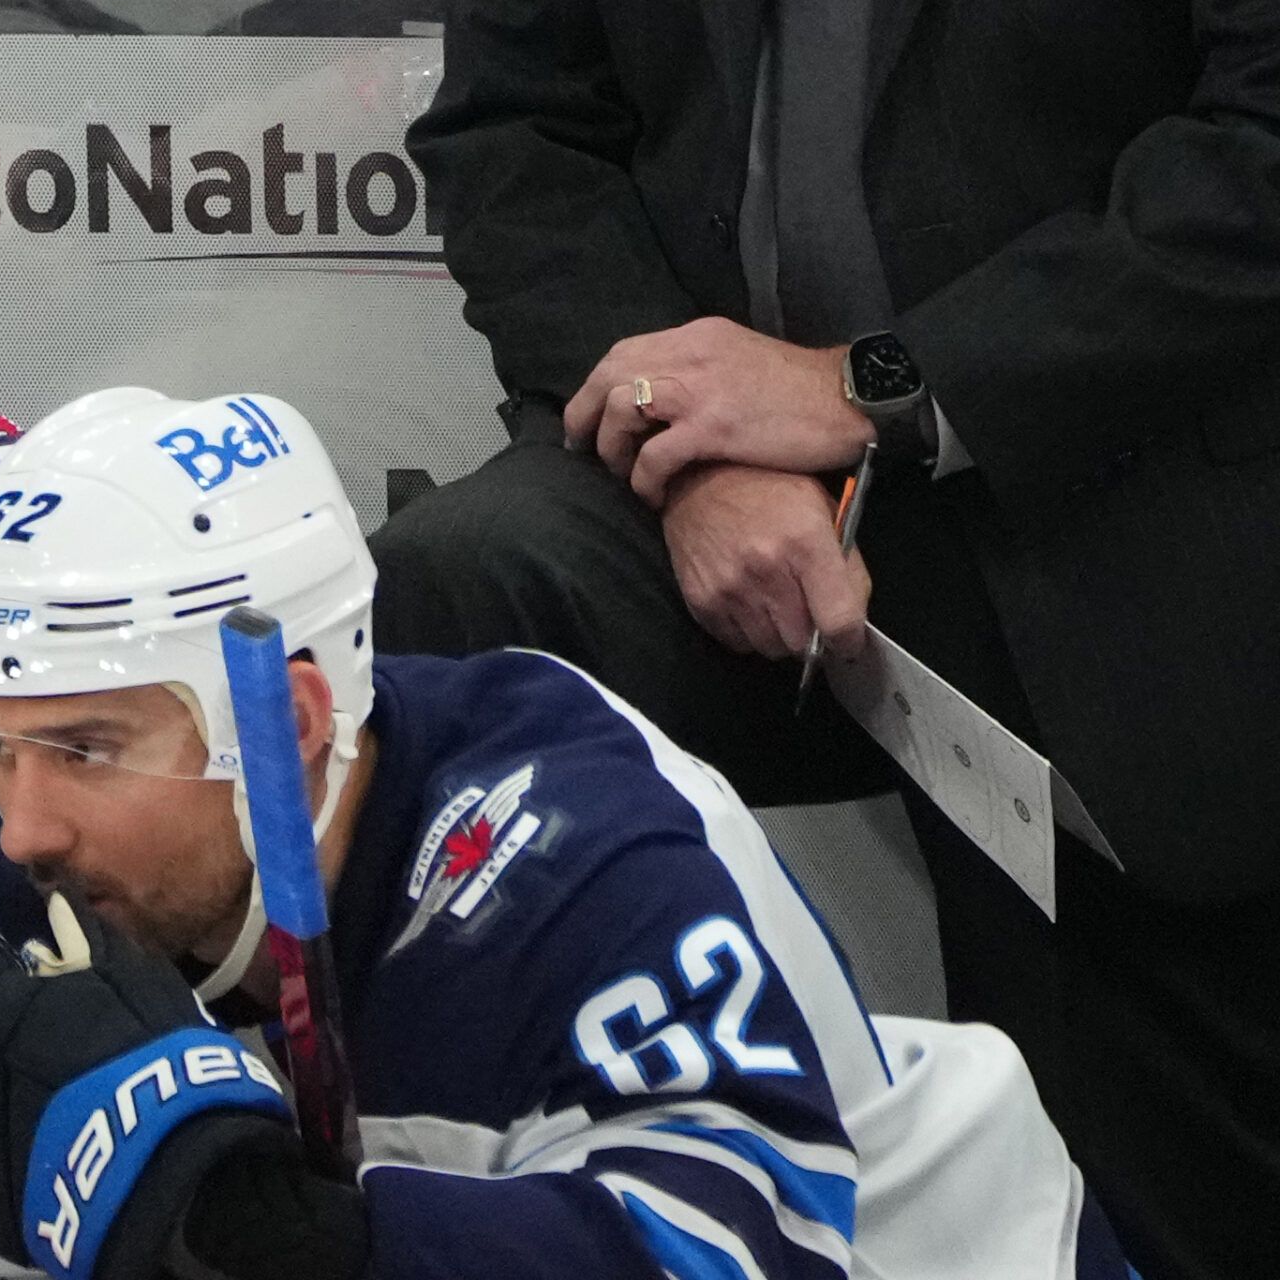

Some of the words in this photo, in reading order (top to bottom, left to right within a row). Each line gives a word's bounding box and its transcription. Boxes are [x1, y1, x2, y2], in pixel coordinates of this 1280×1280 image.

[155, 396, 290, 492] Bell
[479, 838, 519, 888] JETS
[573, 915, 804, 1097] 62
